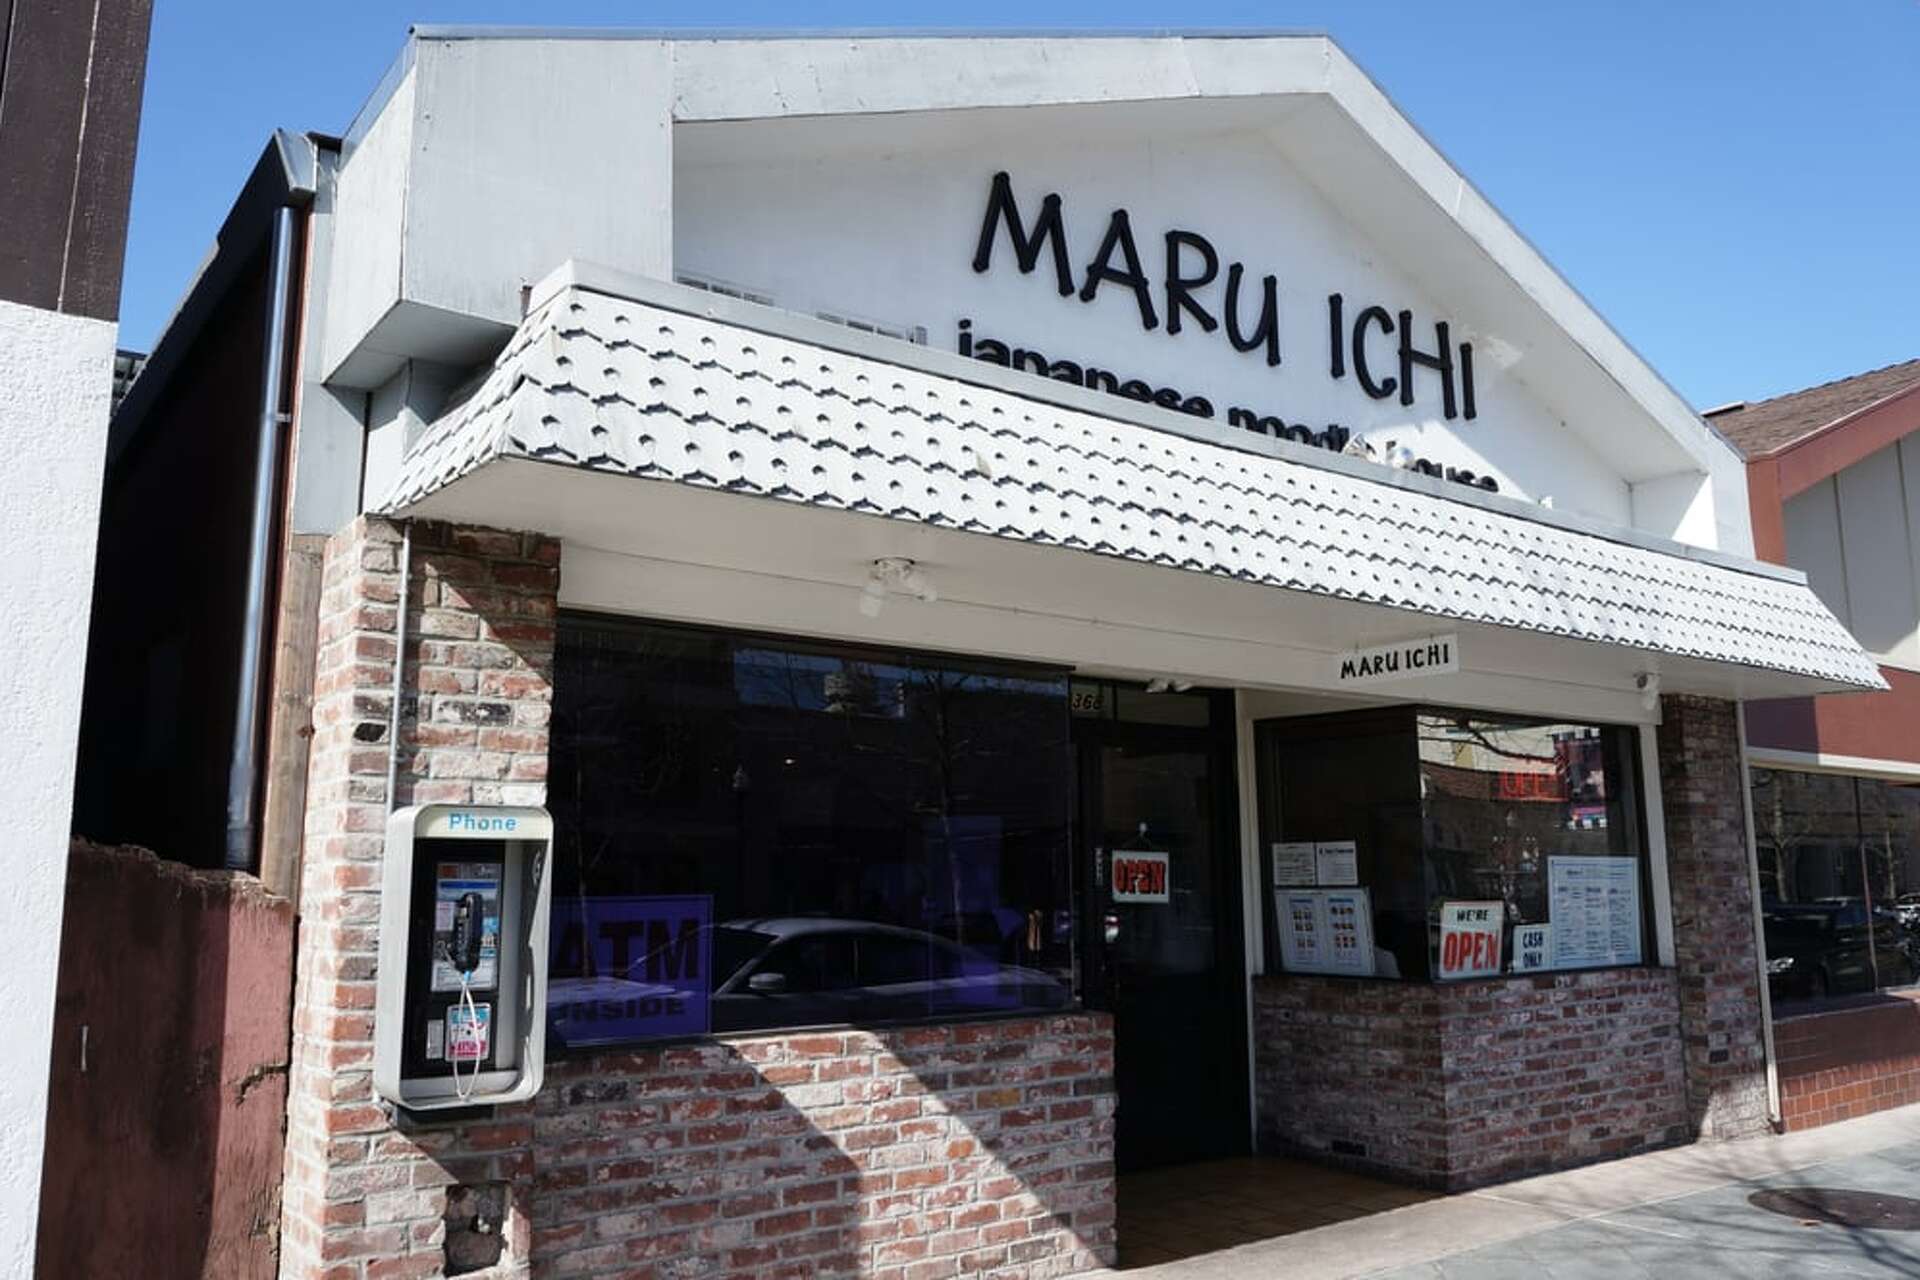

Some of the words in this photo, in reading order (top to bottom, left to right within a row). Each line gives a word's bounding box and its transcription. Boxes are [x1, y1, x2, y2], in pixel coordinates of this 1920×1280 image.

[972, 170, 1282, 367] MARU
[1328, 293, 1477, 420] ICHI
[1341, 651, 1398, 679] MARU
[1406, 643, 1449, 669] ICHI
[449, 813, 517, 831] Phone
[1114, 858, 1166, 895] OPEN
[555, 918, 700, 981] ATM
[1443, 931, 1498, 971] OPEN
[1522, 931, 1543, 948] CASH
[1522, 952, 1542, 968] ONLY
